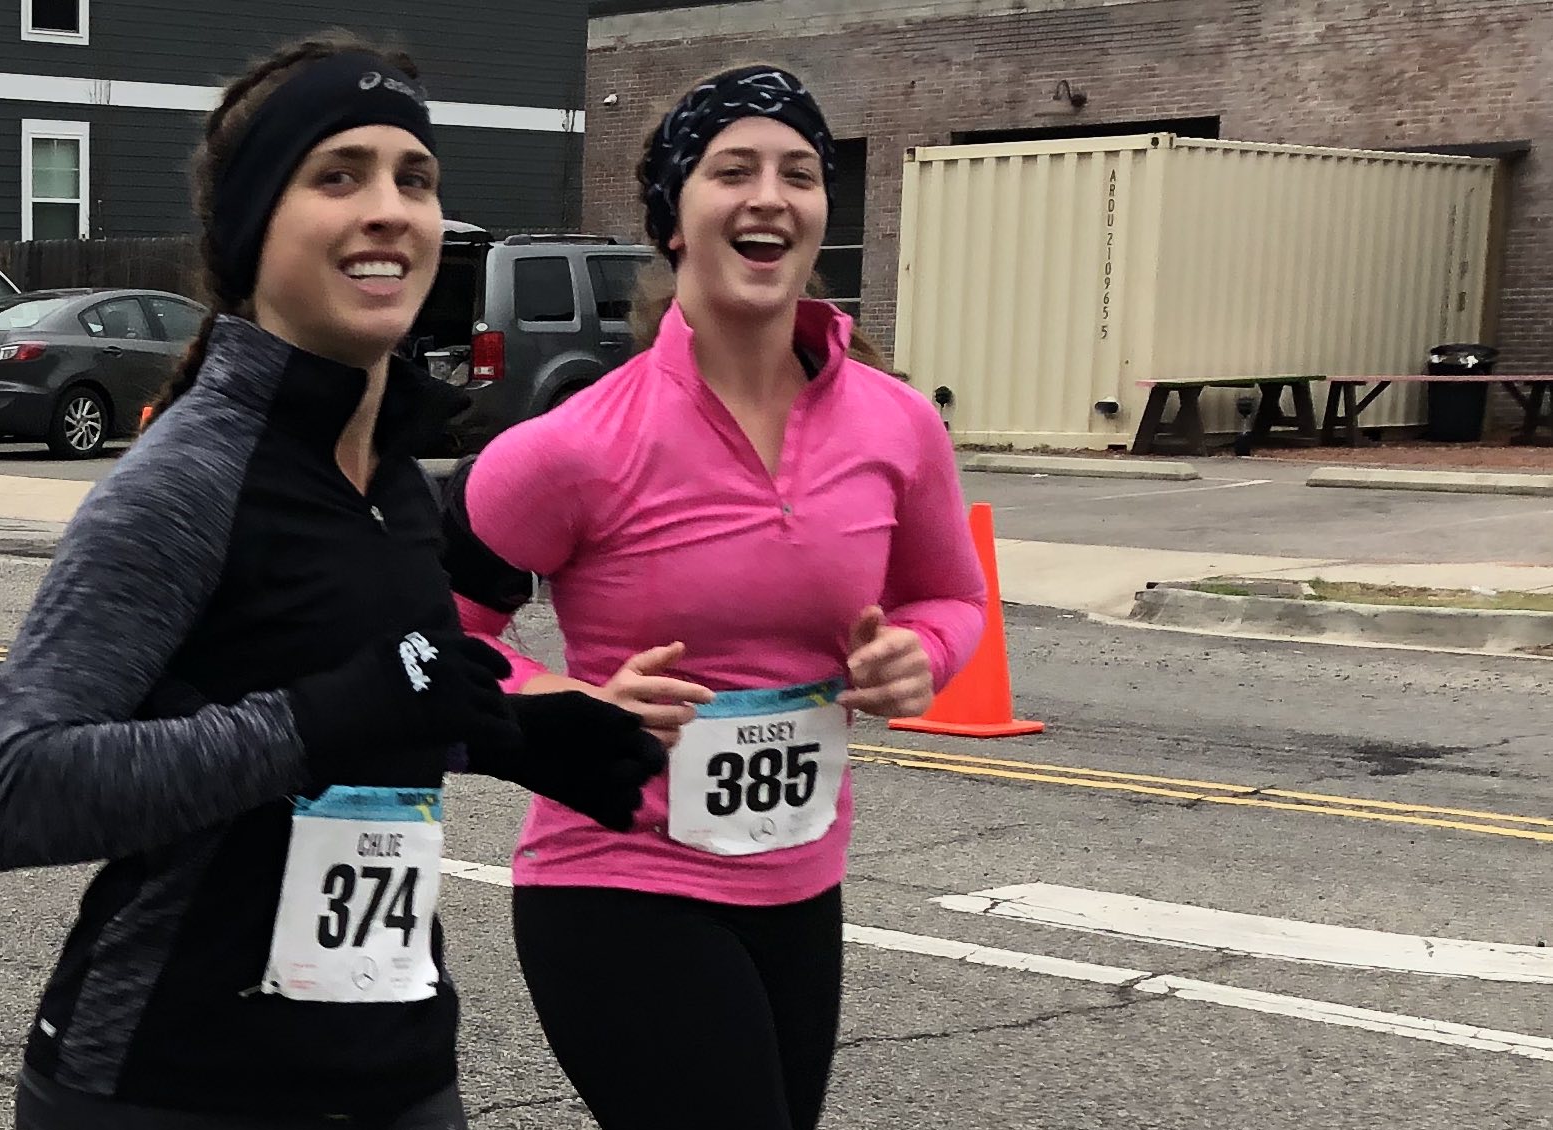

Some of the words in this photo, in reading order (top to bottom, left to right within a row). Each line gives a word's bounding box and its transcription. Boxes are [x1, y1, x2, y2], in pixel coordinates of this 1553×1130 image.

[1107, 169, 1116, 227] ARDU
[1102, 232, 1113, 320] 210965
[736, 720, 796, 745] KELSEY
[705, 742, 821, 816] 385
[357, 832, 404, 857] CHLOE
[317, 863, 420, 949] 374
